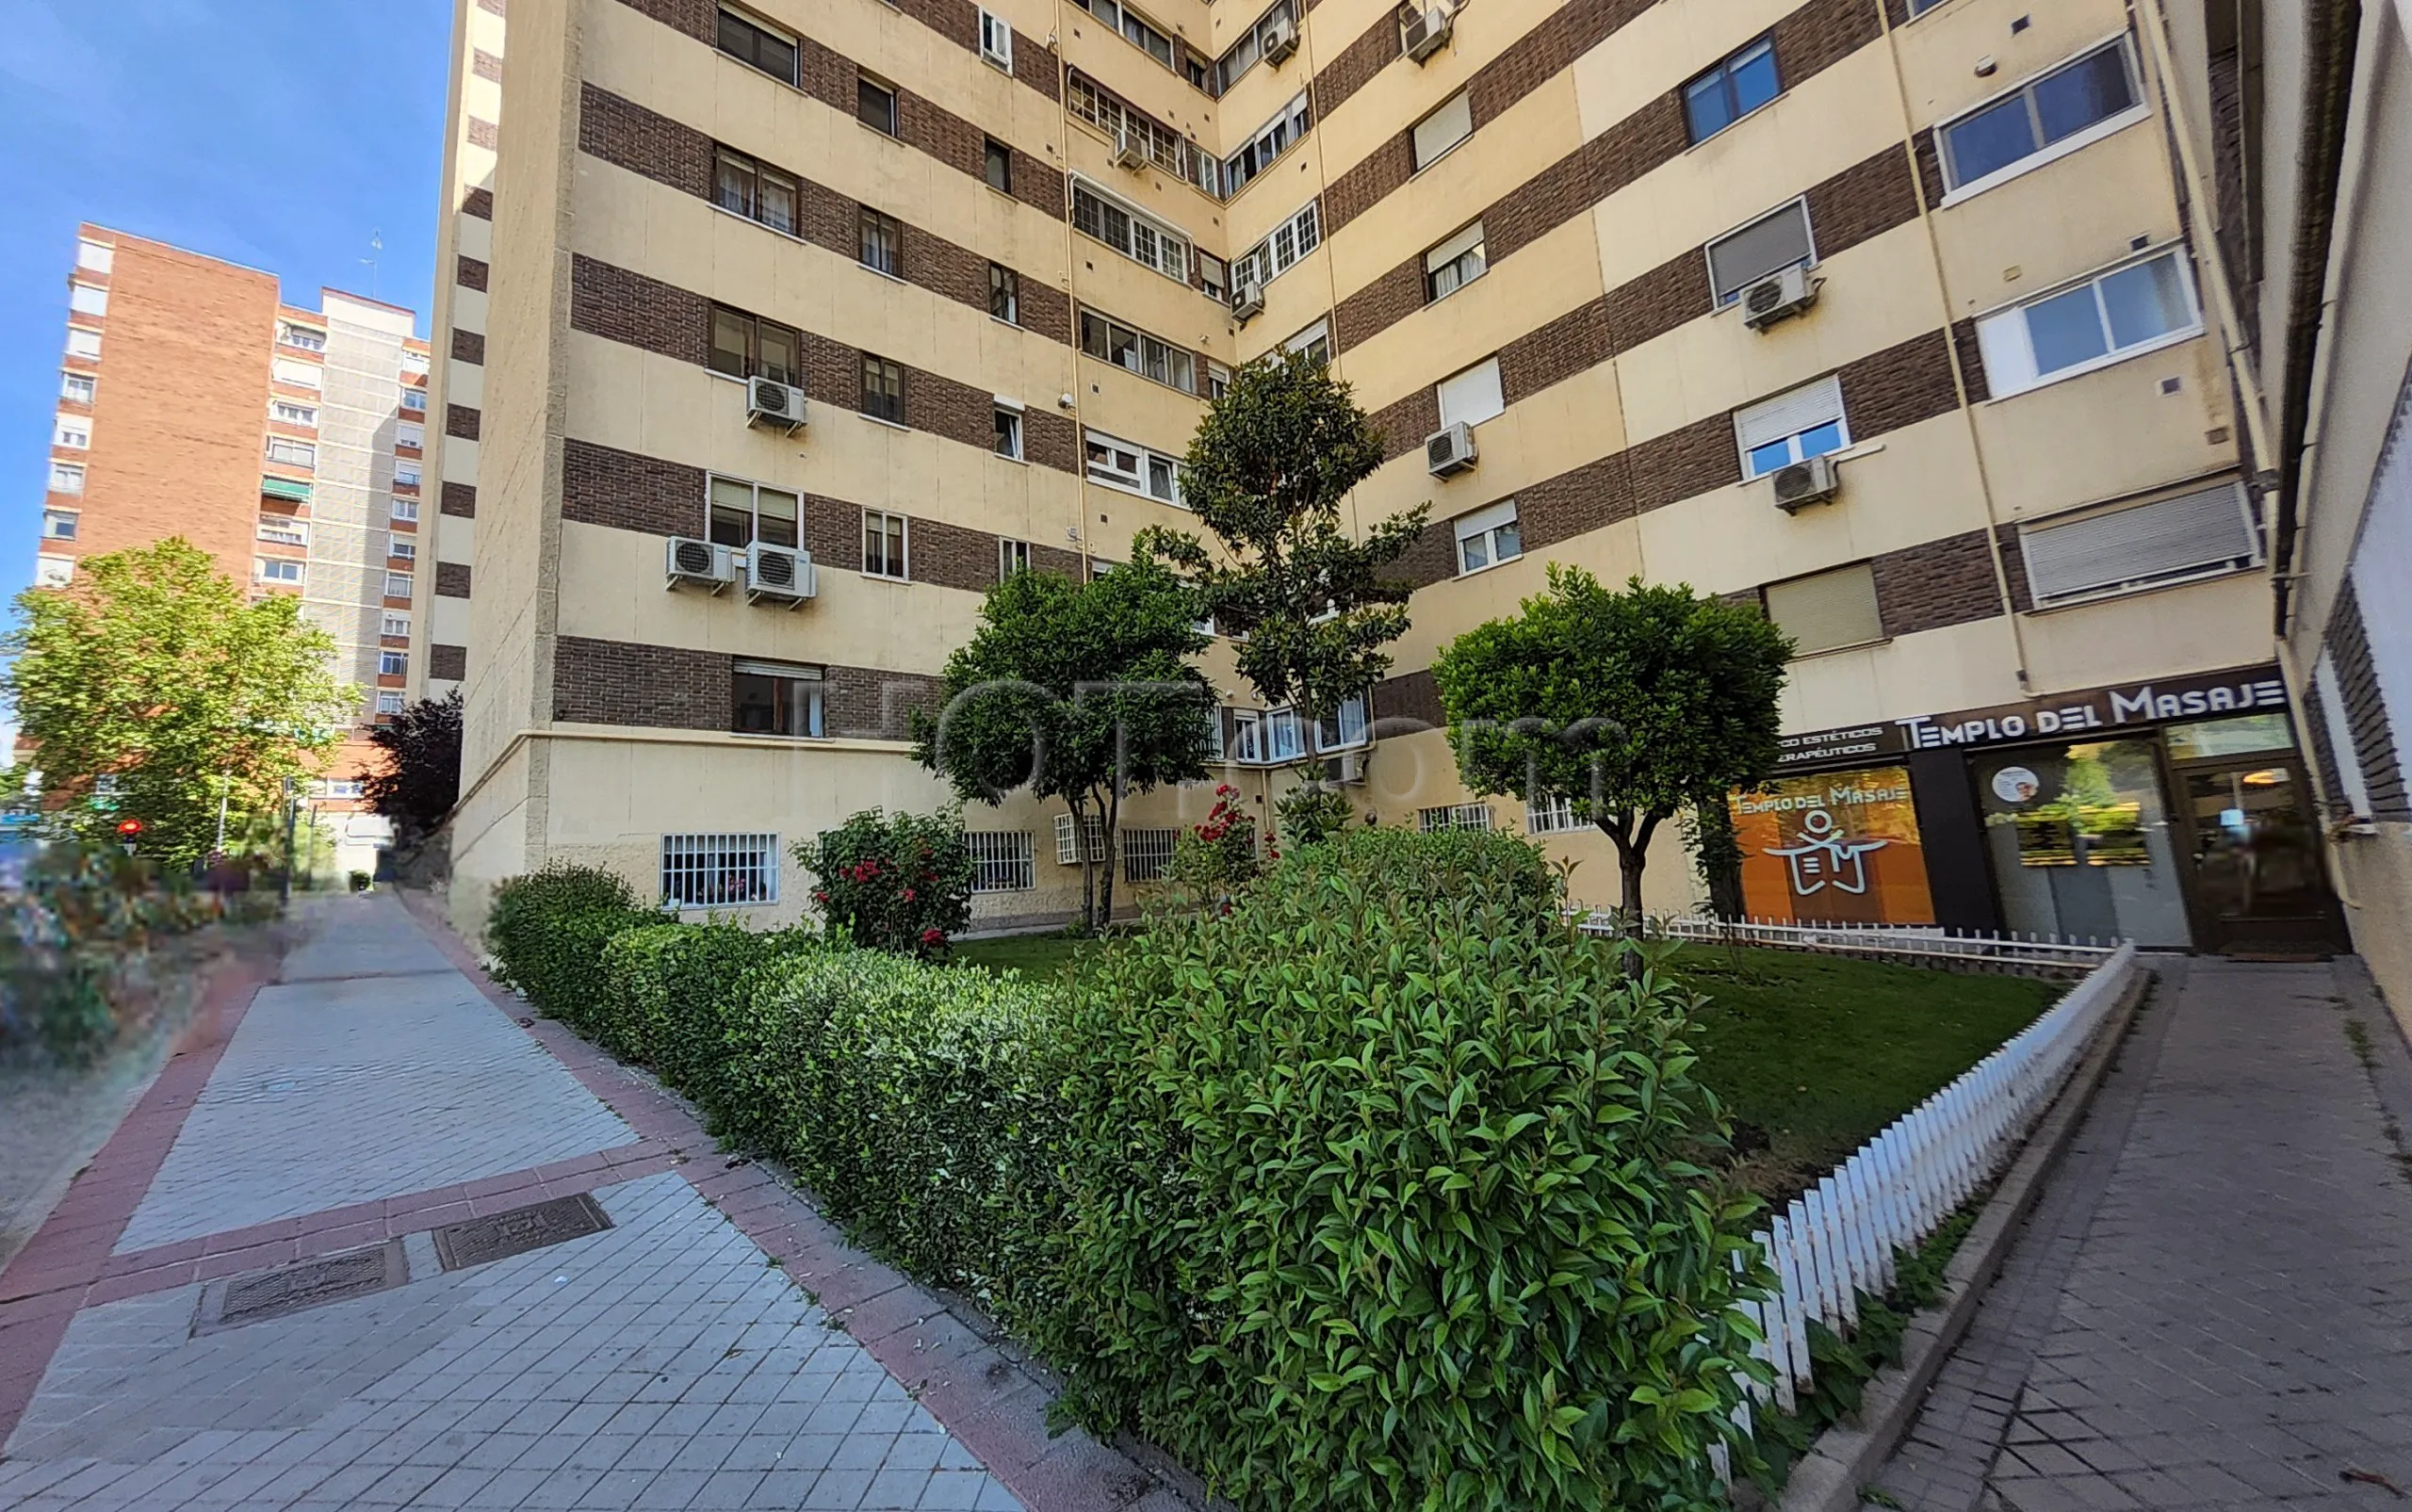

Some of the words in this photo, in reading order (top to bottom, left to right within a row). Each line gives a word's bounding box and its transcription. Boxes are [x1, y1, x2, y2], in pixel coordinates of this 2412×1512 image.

[1895, 716, 2026, 749] TEMPLO
[2036, 705, 2103, 734] DEL
[2109, 679, 2286, 724] MASAJE
[1777, 742, 1877, 763] ERAPÉUTICOS
[1735, 794, 1791, 815] TEMPLO
[1795, 794, 1826, 808] DEL
[1830, 785, 1909, 806] MASAJE
